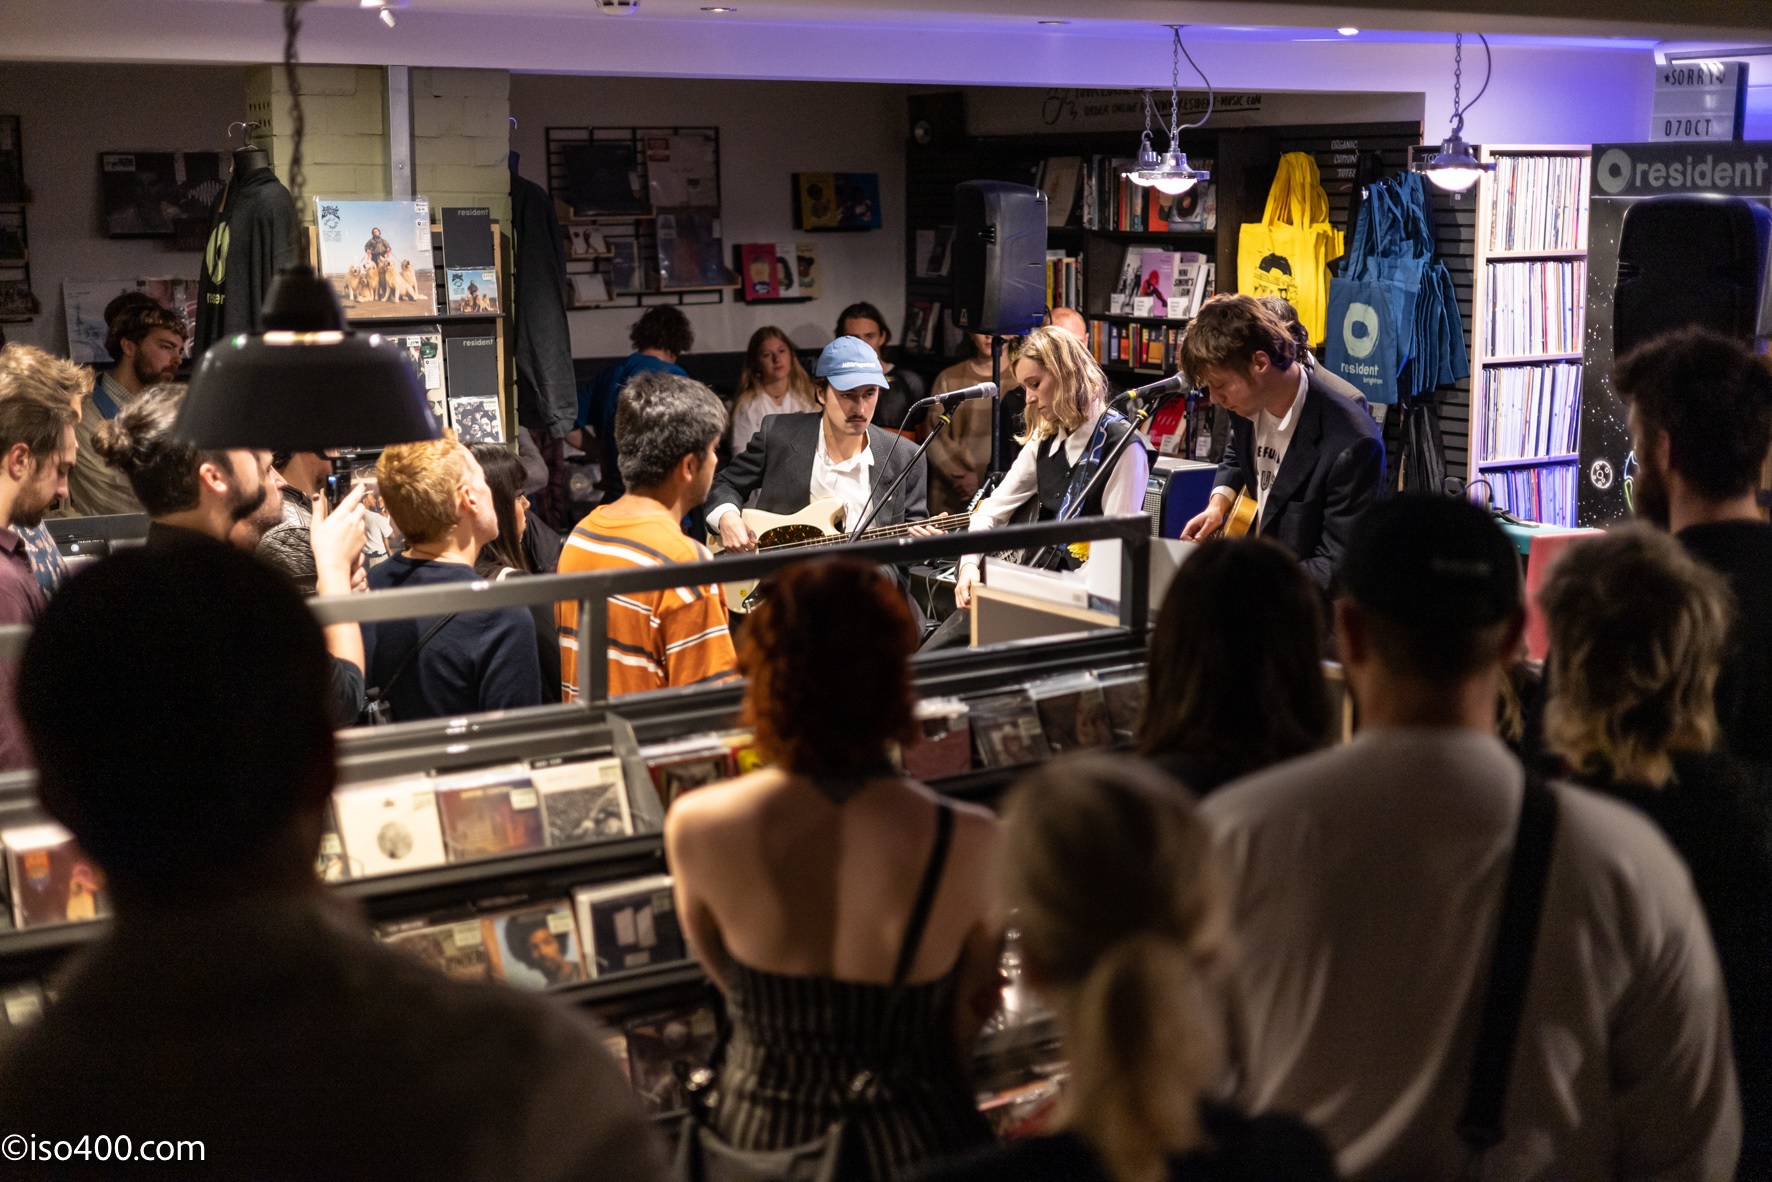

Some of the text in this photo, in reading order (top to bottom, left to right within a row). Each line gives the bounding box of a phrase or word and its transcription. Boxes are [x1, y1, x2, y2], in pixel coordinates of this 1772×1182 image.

[1671, 69, 1714, 86] SORRY
[1331, 139, 1358, 150] ORGANIC
[1333, 154, 1358, 164] COTTON
[1635, 154, 1769, 188] resident
[457, 208, 489, 217] resident
[462, 338, 494, 347] resident
[1340, 363, 1379, 376] resident
[1362, 376, 1383, 386] brighton
